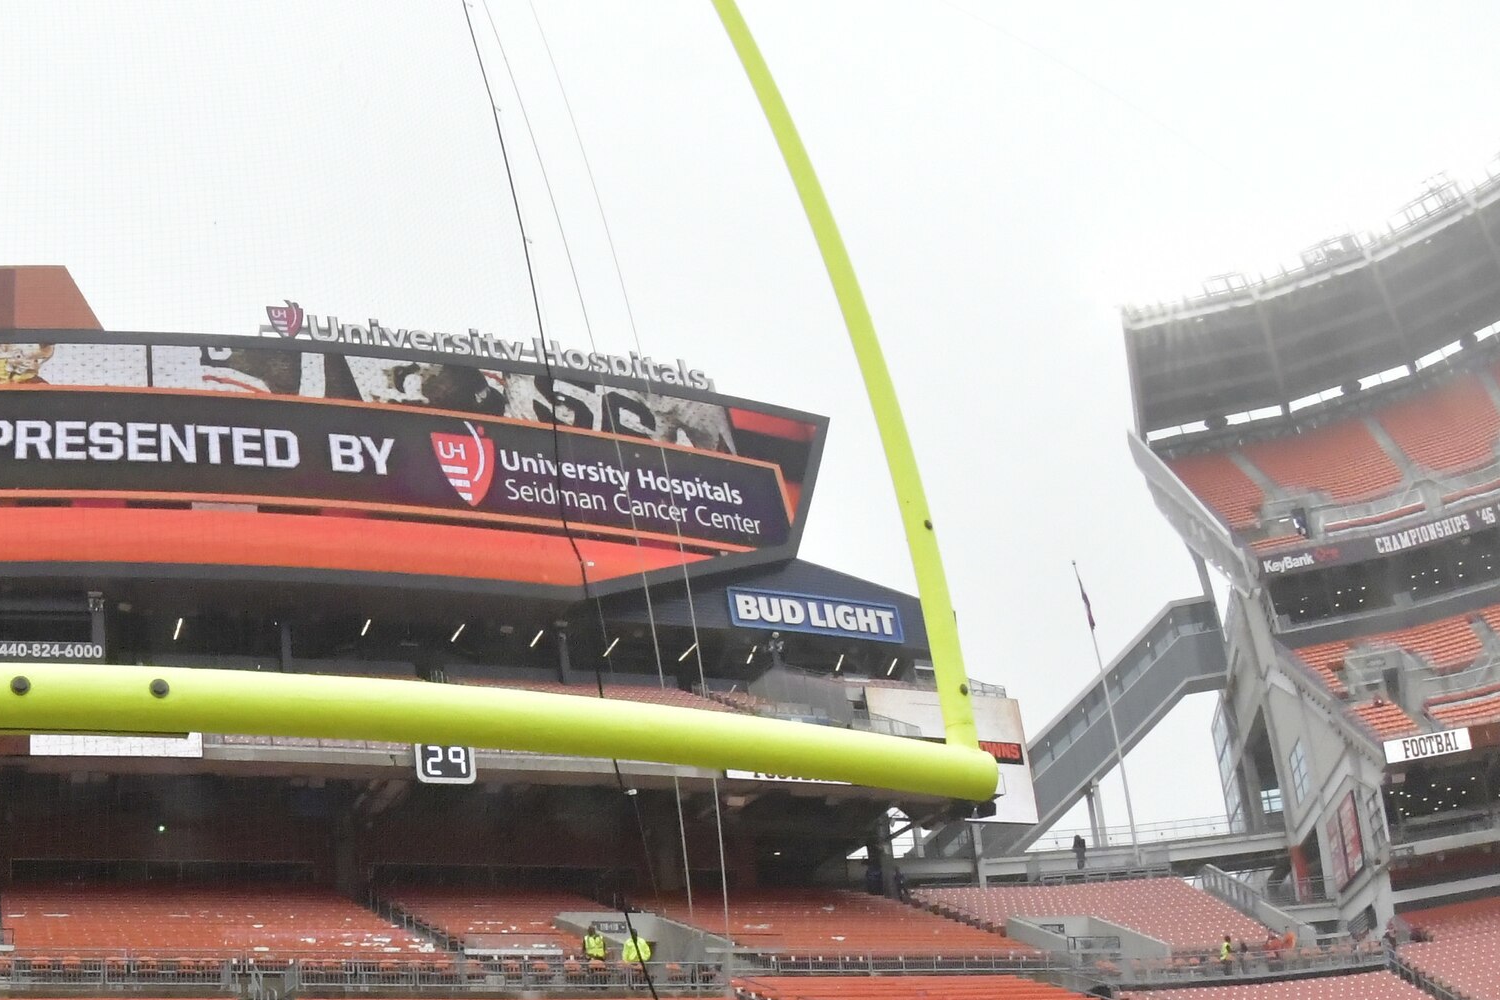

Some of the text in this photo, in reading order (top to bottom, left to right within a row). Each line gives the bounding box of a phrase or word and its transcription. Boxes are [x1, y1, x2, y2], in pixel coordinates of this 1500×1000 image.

[306, 315, 710, 390] University Hospitals
[328, 433, 395, 475] BY
[500, 449, 743, 506] University Hospitals
[504, 478, 762, 535] Seidman Cancer Center
[1375, 514, 1471, 554] CHAMPIONSHIPS
[1263, 553, 1315, 574] KeyBank
[735, 594, 895, 635] BUD LIGHT
[426, 745, 467, 775] 29
